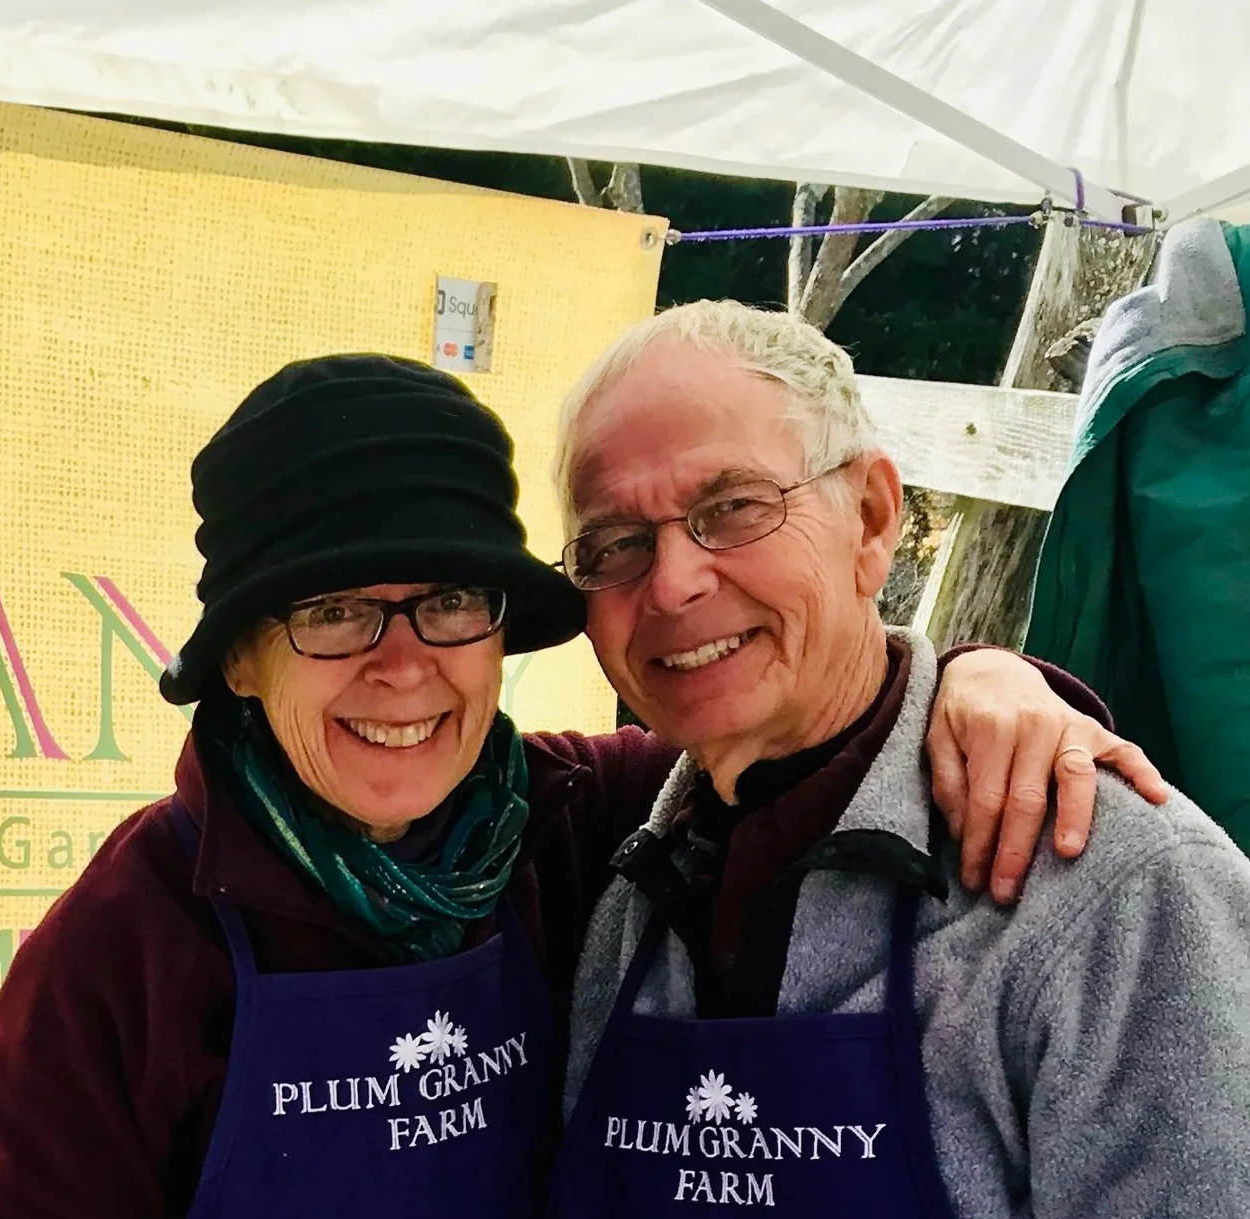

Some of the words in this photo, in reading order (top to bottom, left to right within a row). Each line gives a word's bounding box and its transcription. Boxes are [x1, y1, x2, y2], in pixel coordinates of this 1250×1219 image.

[449, 295, 478, 318] Squ
[273, 1073, 401, 1116] PLUM
[419, 1032, 528, 1100] GRANNY
[388, 1097, 487, 1150] FARM
[604, 1116, 691, 1156] PLUM
[699, 1123, 886, 1160] GRANNY
[674, 1168, 776, 1207] FARM
